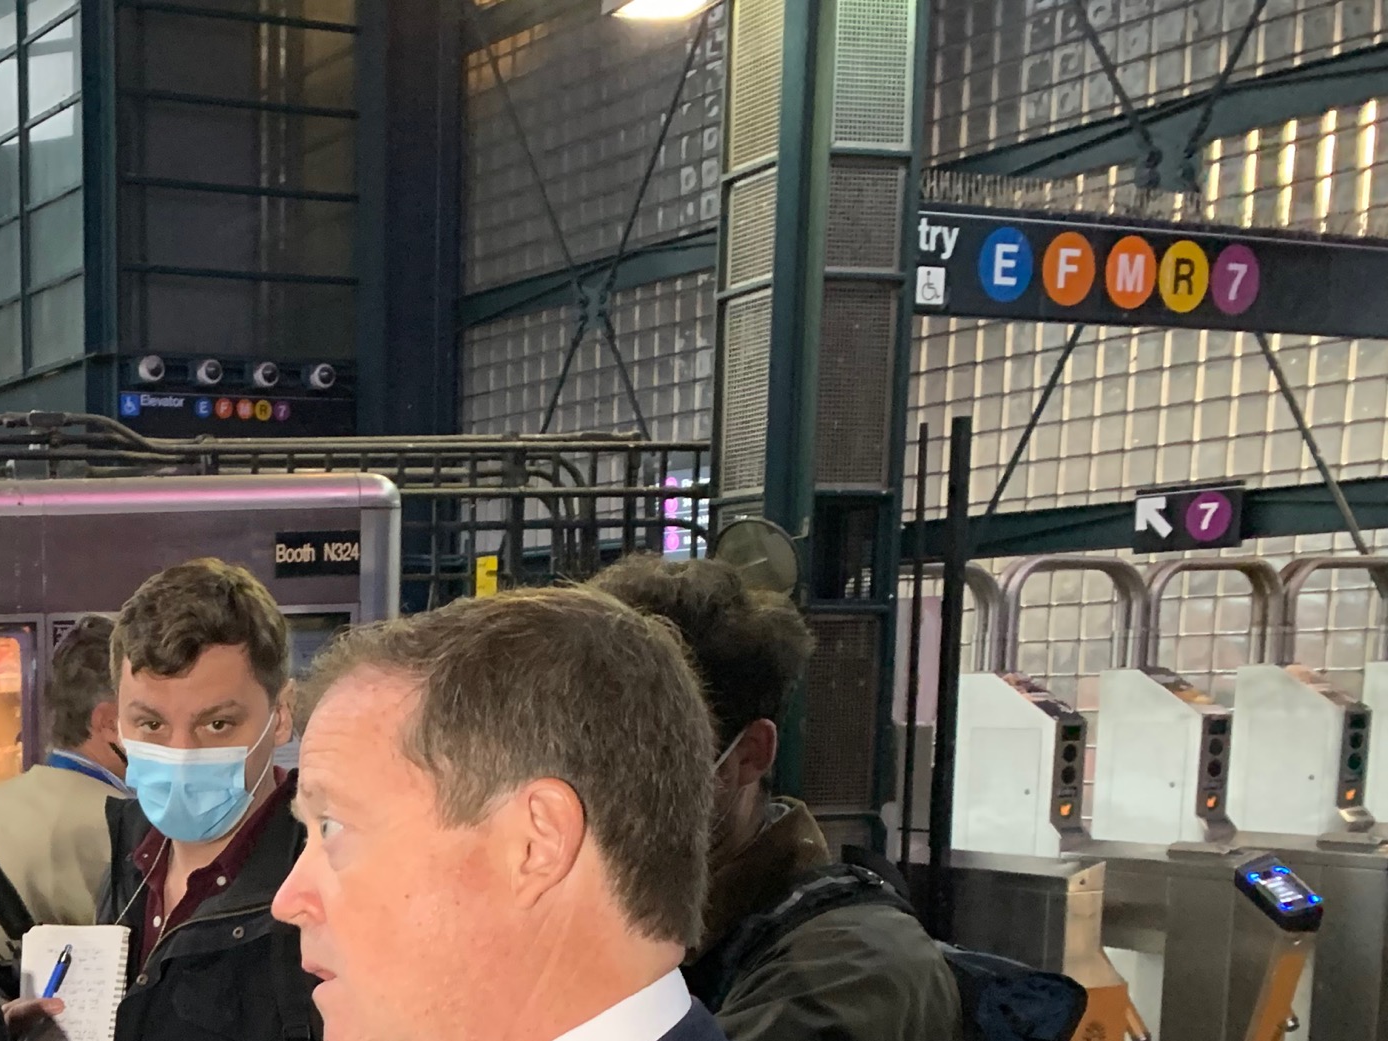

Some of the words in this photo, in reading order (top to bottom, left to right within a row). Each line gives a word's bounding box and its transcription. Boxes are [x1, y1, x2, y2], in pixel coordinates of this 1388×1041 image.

[992, 244, 1018, 286] E
[1056, 248, 1081, 289] F
[1117, 254, 1146, 292] M
[1173, 258, 1194, 296] R
[1227, 263, 1249, 301] 7
[140, 394, 185, 408] Elevator
[1198, 502, 1219, 530] 7
[275, 543, 315, 563] Booth
[324, 542, 360, 562] N324
